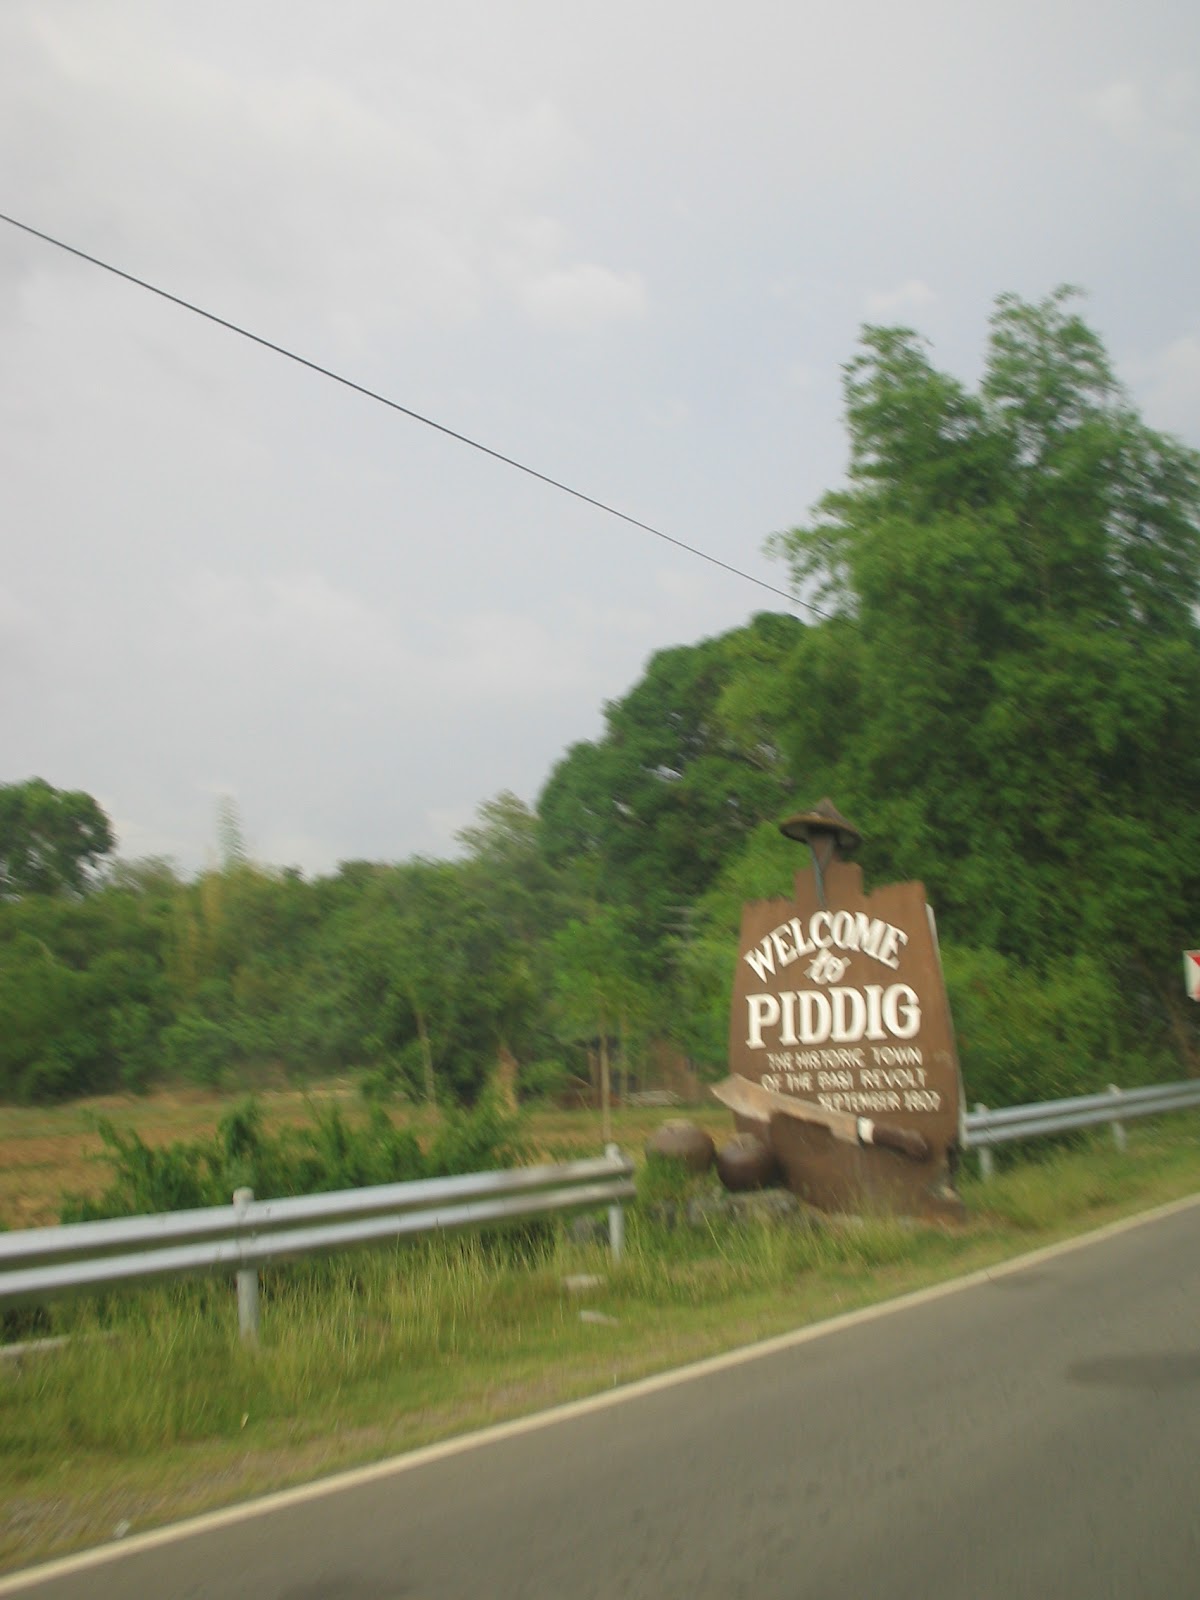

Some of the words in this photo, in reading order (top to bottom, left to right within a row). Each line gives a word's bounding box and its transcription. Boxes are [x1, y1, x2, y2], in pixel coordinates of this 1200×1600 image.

[744, 910, 908, 983] WELCOME
[804, 948, 851, 984] to
[745, 983, 921, 1049] PIDDIG
[767, 1052, 794, 1071] THE
[795, 1047, 865, 1069] HISTORIC
[871, 1046, 922, 1066] TOWN
[761, 1074, 782, 1092] OF
[785, 1072, 813, 1091] THE
[860, 1068, 927, 1088] REVOLT
[817, 1092, 901, 1112] SEPTEMBER
